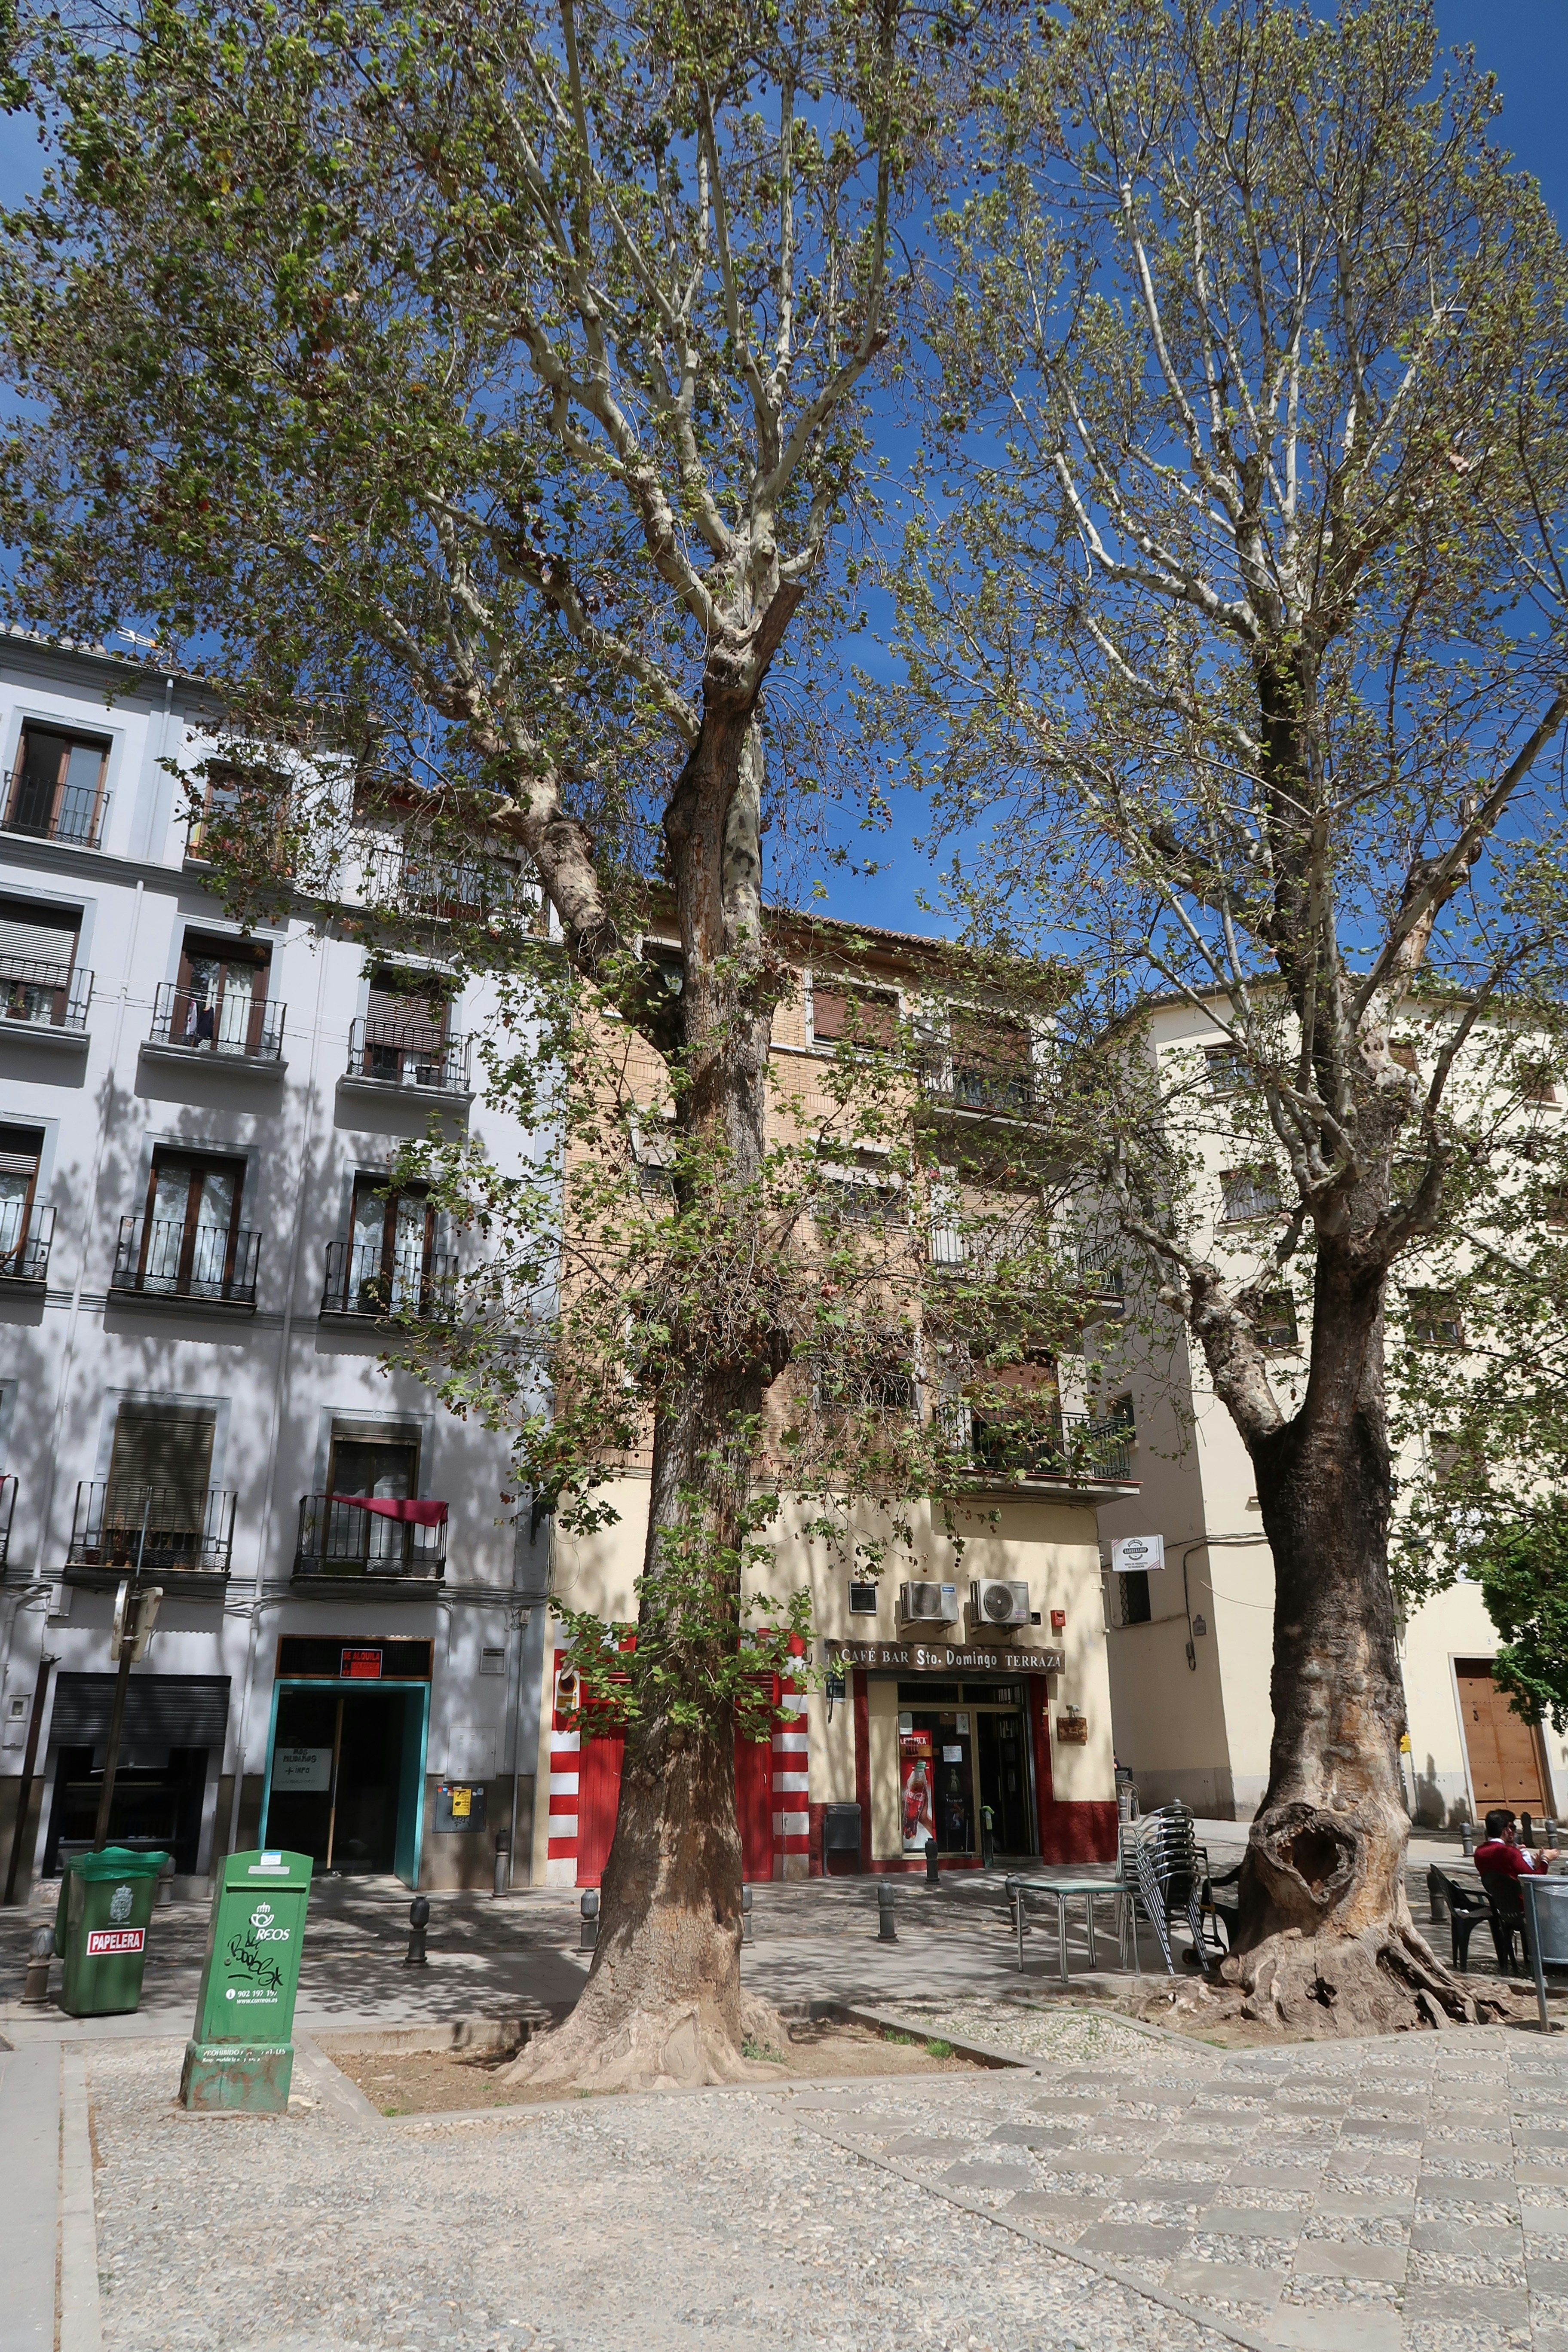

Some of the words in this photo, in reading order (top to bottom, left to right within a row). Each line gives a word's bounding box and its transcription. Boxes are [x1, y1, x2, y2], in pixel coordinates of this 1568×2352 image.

[343, 1652, 351, 1660] SE
[353, 1652, 380, 1661] ALQUILA
[841, 1647, 876, 1662] CAFÉ
[882, 1651, 909, 1663] BAR
[916, 1649, 942, 1665] Sto.
[946, 1649, 997, 1668] Domingo
[1005, 1655, 1060, 1667] TERRAZA
[92, 1933, 140, 1951] PAPELERA
